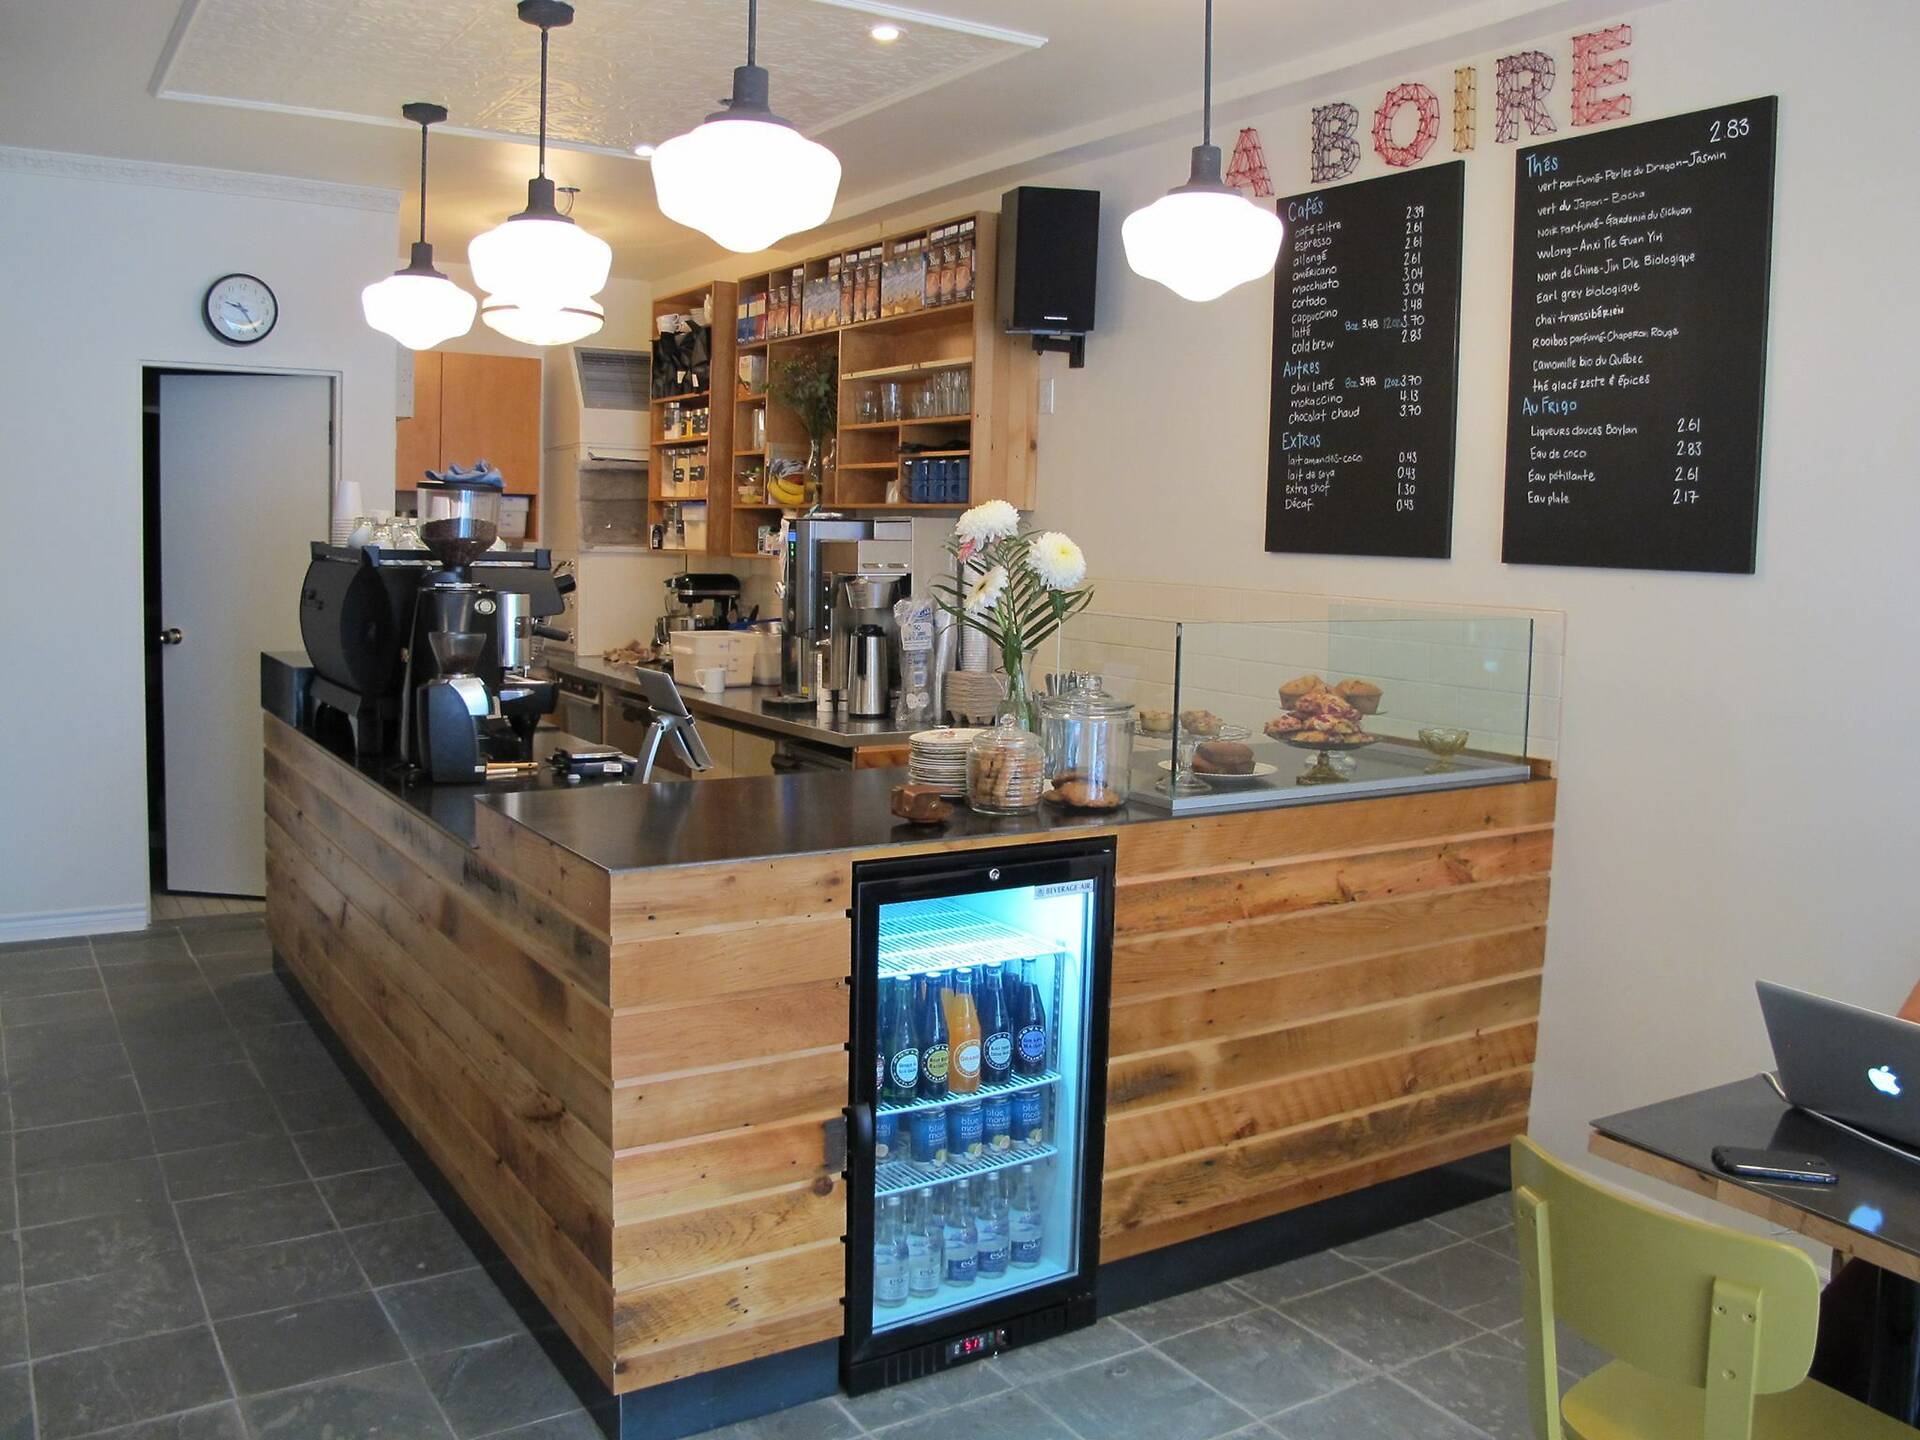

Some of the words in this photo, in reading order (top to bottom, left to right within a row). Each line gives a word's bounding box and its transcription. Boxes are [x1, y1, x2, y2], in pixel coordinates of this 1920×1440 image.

[1225, 128, 1275, 197] A
[1311, 24, 1632, 184] BOIRE
[1526, 152, 1559, 178] Thés
[1709, 118, 1750, 143] 2.83
[1538, 179, 1557, 193] vert
[1605, 167, 1632, 182] Perles
[1633, 165, 1644, 177] du
[1288, 197, 1323, 222] Cafés
[1406, 205, 1425, 220] 2.39
[1538, 203, 1556, 217] vert
[1559, 200, 1571, 212] du
[1647, 210, 1659, 222] du
[1294, 236, 1332, 252] espresso
[1406, 221, 1423, 235] 2.61
[1404, 236, 1423, 250] 2.61
[1619, 234, 1644, 248] Guan
[1403, 252, 1421, 266] 2.61
[1560, 266, 1572, 280] de
[1622, 257, 1640, 271] Die
[1292, 280, 1340, 295] macchiato
[1402, 267, 1423, 282] 3.04
[1291, 293, 1327, 309] cortado
[1402, 282, 1424, 296] 3.04
[1536, 290, 1557, 304] Earl
[1561, 287, 1583, 302] grey
[1585, 280, 1640, 298] biologique
[1291, 308, 1338, 325] cappuccino
[1402, 298, 1422, 312] 3.48
[1361, 318, 1379, 330] 3.48
[1401, 314, 1425, 328] 3.70
[1650, 326, 1679, 339] Rouge
[1291, 340, 1310, 355] cold
[1312, 338, 1335, 351] brew
[1401, 330, 1422, 344] 2.83
[1579, 356, 1593, 368] bio
[1595, 355, 1607, 367] du
[1400, 375, 1422, 387] 3.70
[1532, 378, 1549, 393] thé
[1552, 376, 1578, 393] glacé
[1580, 375, 1605, 389] zeste
[1617, 373, 1651, 388] épices
[1291, 394, 1343, 408] mokaccino
[1400, 389, 1419, 402] 4.13
[1522, 397, 1539, 417] Au
[1288, 408, 1327, 424] chocolat
[1331, 406, 1360, 420] chaud
[1399, 404, 1421, 418] 3.70
[1571, 424, 1602, 436] douces
[1606, 423, 1638, 436] Boylan
[1677, 417, 1700, 433] 2.61
[1287, 454, 1303, 466] lait
[1399, 451, 1417, 464] 0.43
[1530, 446, 1547, 460] Eau
[1549, 447, 1560, 459] de
[1563, 449, 1587, 459] coco
[1676, 441, 1702, 456] 2.83
[1287, 468, 1303, 481] lait
[1305, 470, 1316, 480] de
[1318, 469, 1335, 484] soya
[1397, 466, 1416, 481] 0.43
[1528, 469, 1546, 482] Eau
[1674, 466, 1699, 481] 2.61
[1285, 484, 1308, 496] extra
[1397, 484, 1416, 496] 1.30
[1528, 490, 1546, 504] Eau
[1548, 491, 1569, 505] plate
[1673, 488, 1700, 505] 2.17
[1285, 497, 1314, 512] Décaf
[1396, 499, 1414, 512] 0.43
